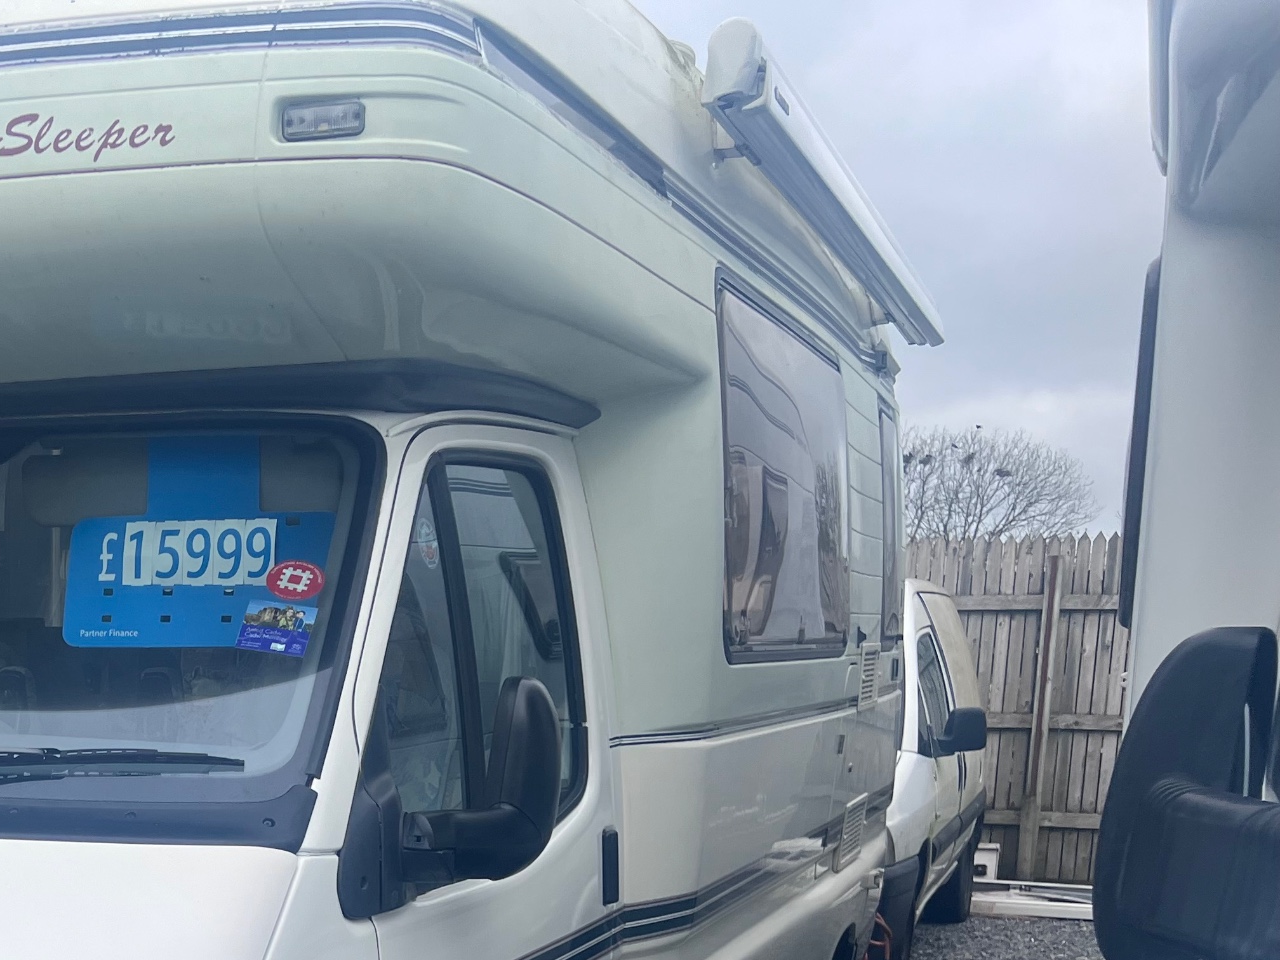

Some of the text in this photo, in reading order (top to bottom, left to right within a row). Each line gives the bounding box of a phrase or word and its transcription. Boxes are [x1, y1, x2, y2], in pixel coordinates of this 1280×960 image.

[98, 526, 272, 582] £15999
[79, 629, 139, 638] Partner Finance
